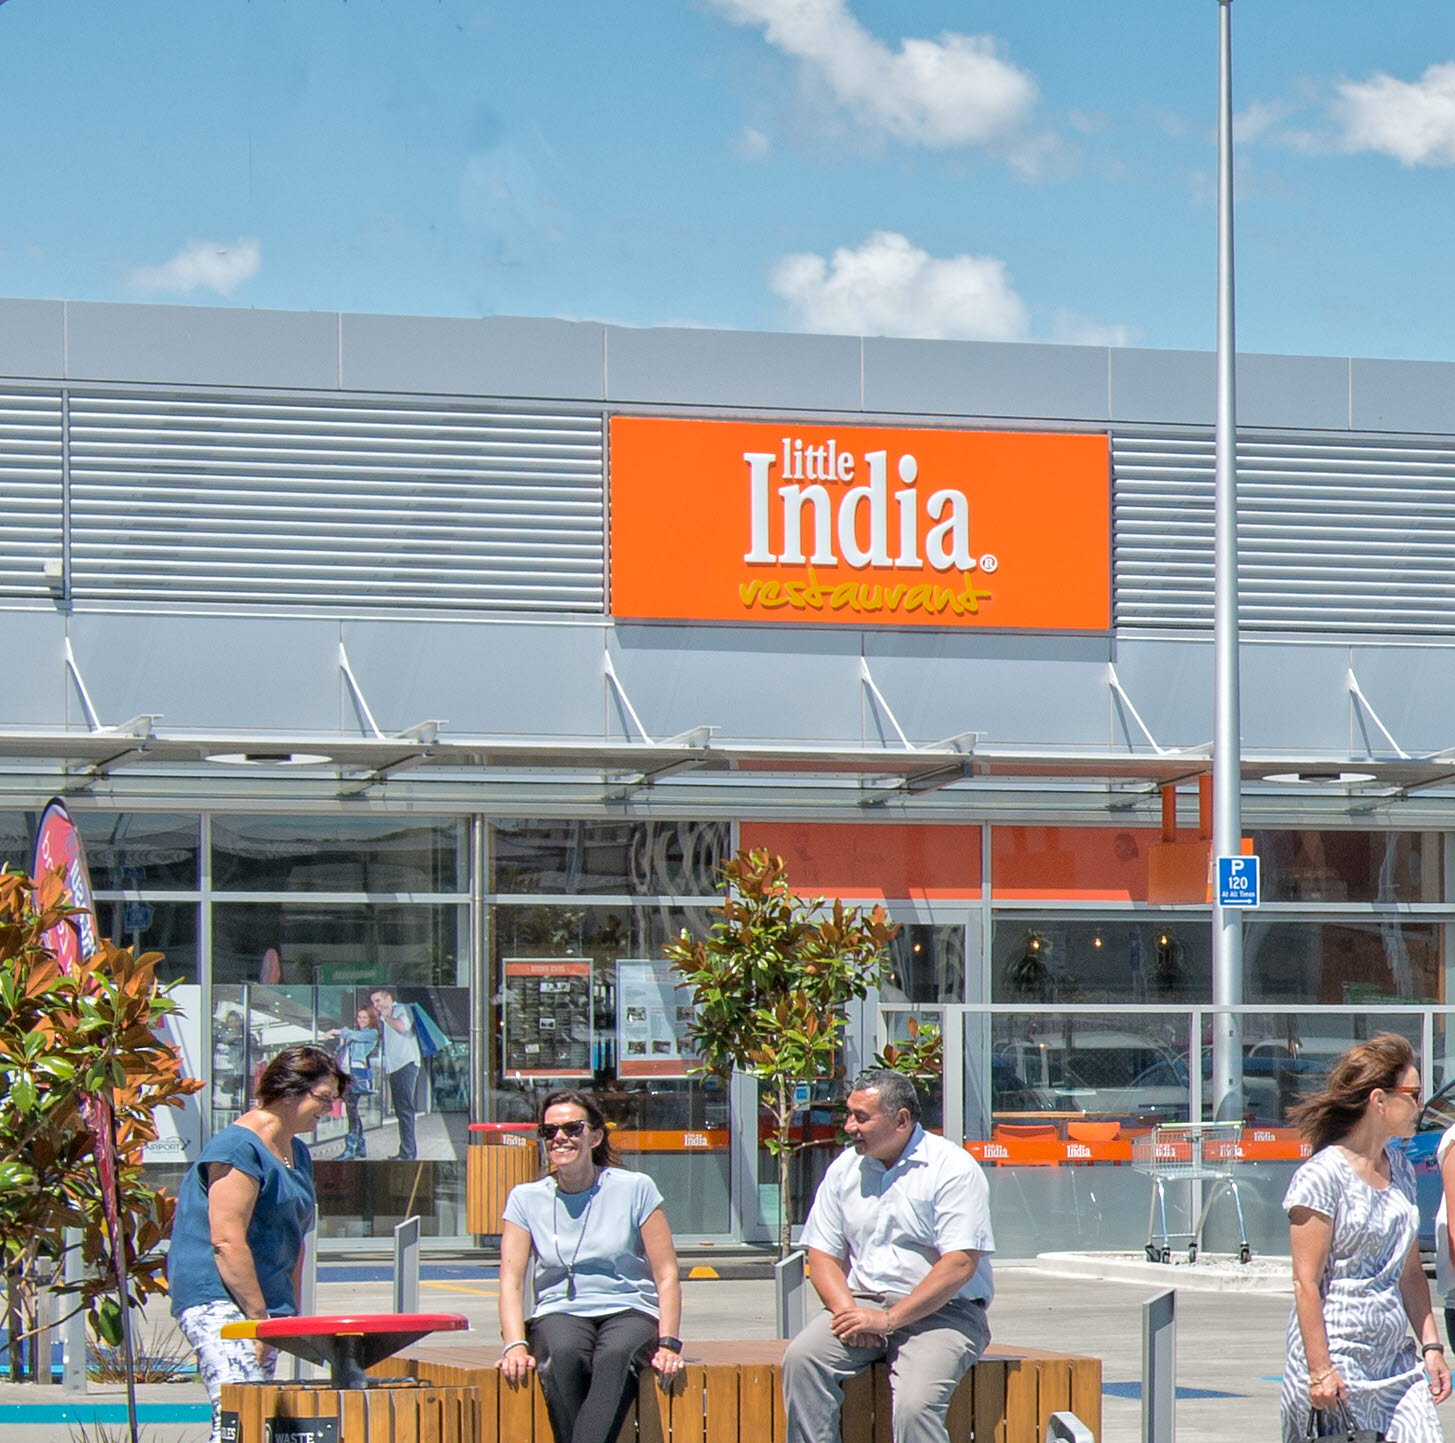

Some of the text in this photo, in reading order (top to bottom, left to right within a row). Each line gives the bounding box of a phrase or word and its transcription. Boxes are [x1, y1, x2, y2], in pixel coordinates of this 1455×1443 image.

[781, 437, 855, 481] little
[743, 450, 977, 571] India
[739, 567, 992, 614] restaurant
[1228, 876, 1249, 890] 120
[1231, 859, 1245, 876] P
